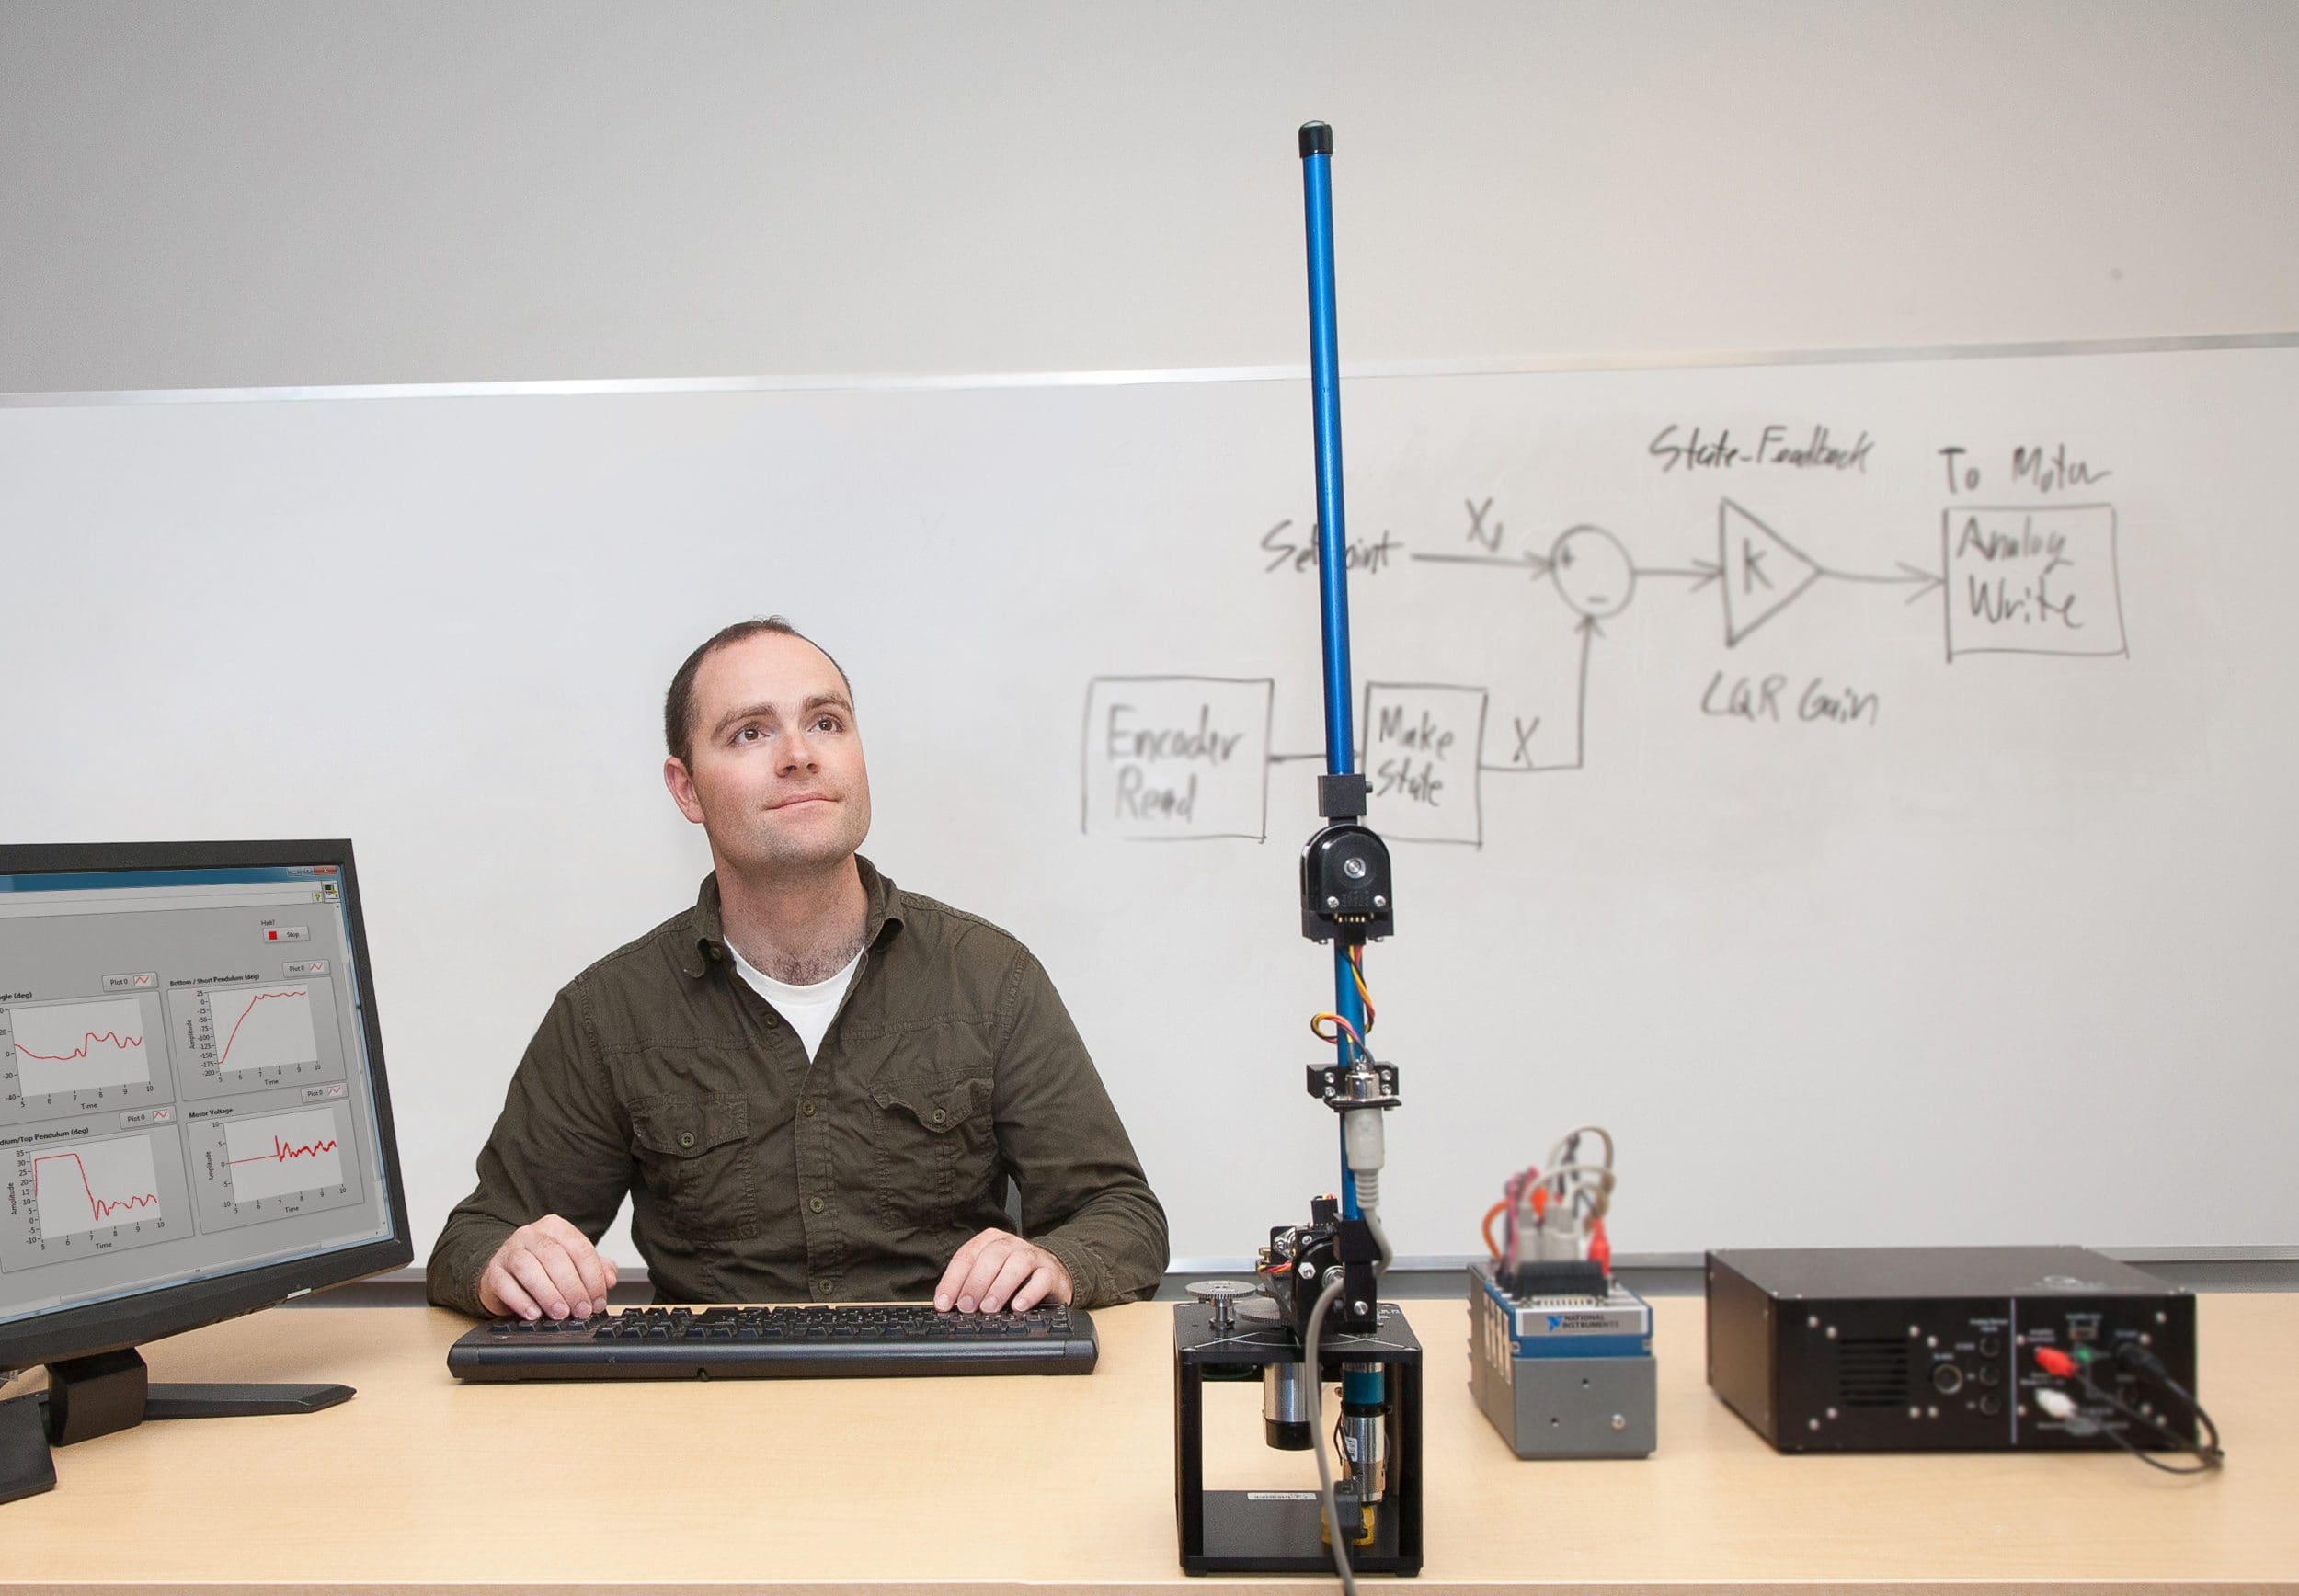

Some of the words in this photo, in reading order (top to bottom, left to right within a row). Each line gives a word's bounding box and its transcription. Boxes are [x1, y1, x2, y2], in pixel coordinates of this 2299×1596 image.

[1937, 446, 1981, 495] To
[1955, 514, 2066, 564] Analog
[1967, 563, 2086, 630] Write
[1107, 704, 1246, 763] Encoder
[1379, 706, 1456, 760] Make
[1115, 764, 1198, 824] Read
[1377, 758, 1445, 806] State
[109, 978, 123, 986] Plot
[213, 975, 244, 983] Pendulum
[14, 991, 33, 1000] (deg)
[187, 1019, 195, 1050] Amplitude
[127, 1114, 141, 1123] Plot
[189, 1111, 208, 1119] Motor
[209, 1106, 234, 1117] Voltage
[34, 1131, 70, 1141] Pendulum
[70, 1127, 89, 1136] (deg)
[205, 1150, 214, 1181] Amplitude
[6, 1182, 17, 1215] Amplitude
[95, 1241, 112, 1249] Time
